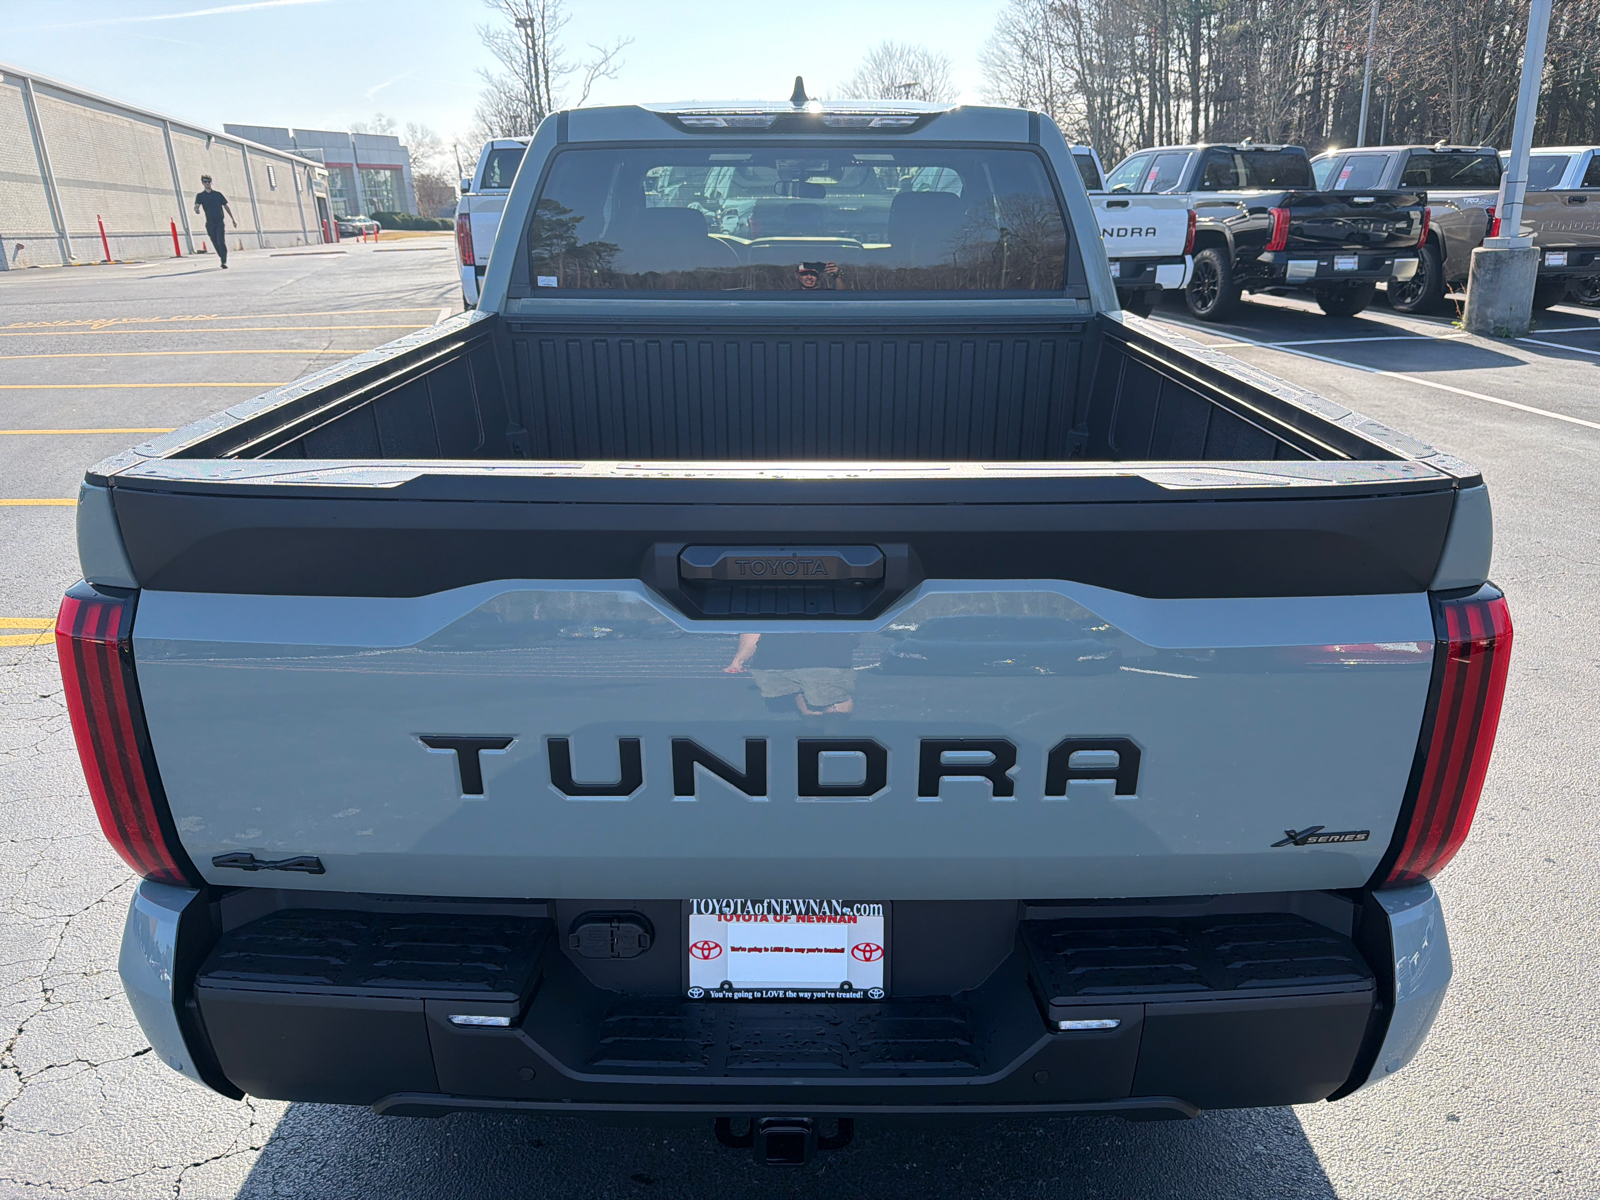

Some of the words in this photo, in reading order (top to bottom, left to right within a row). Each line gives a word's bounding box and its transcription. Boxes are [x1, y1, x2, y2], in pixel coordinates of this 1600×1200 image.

[1537, 220, 1600, 231] TUNDR
[1102, 227, 1157, 238] NDRA
[735, 559, 828, 577] TOYOTA
[416, 734, 1142, 799] TUNDRA
[1306, 834, 1367, 843] SERIES
[717, 914, 769, 922] TOYOTA
[773, 915, 792, 923] OF
[796, 915, 858, 924] NEWNAN
[710, 990, 732, 998] You're
[733, 990, 753, 999] going
[762, 990, 785, 998] LOVE
[785, 990, 797, 998] the
[798, 991, 812, 999] way
[813, 991, 835, 999] you're
[836, 991, 864, 999] treated!
